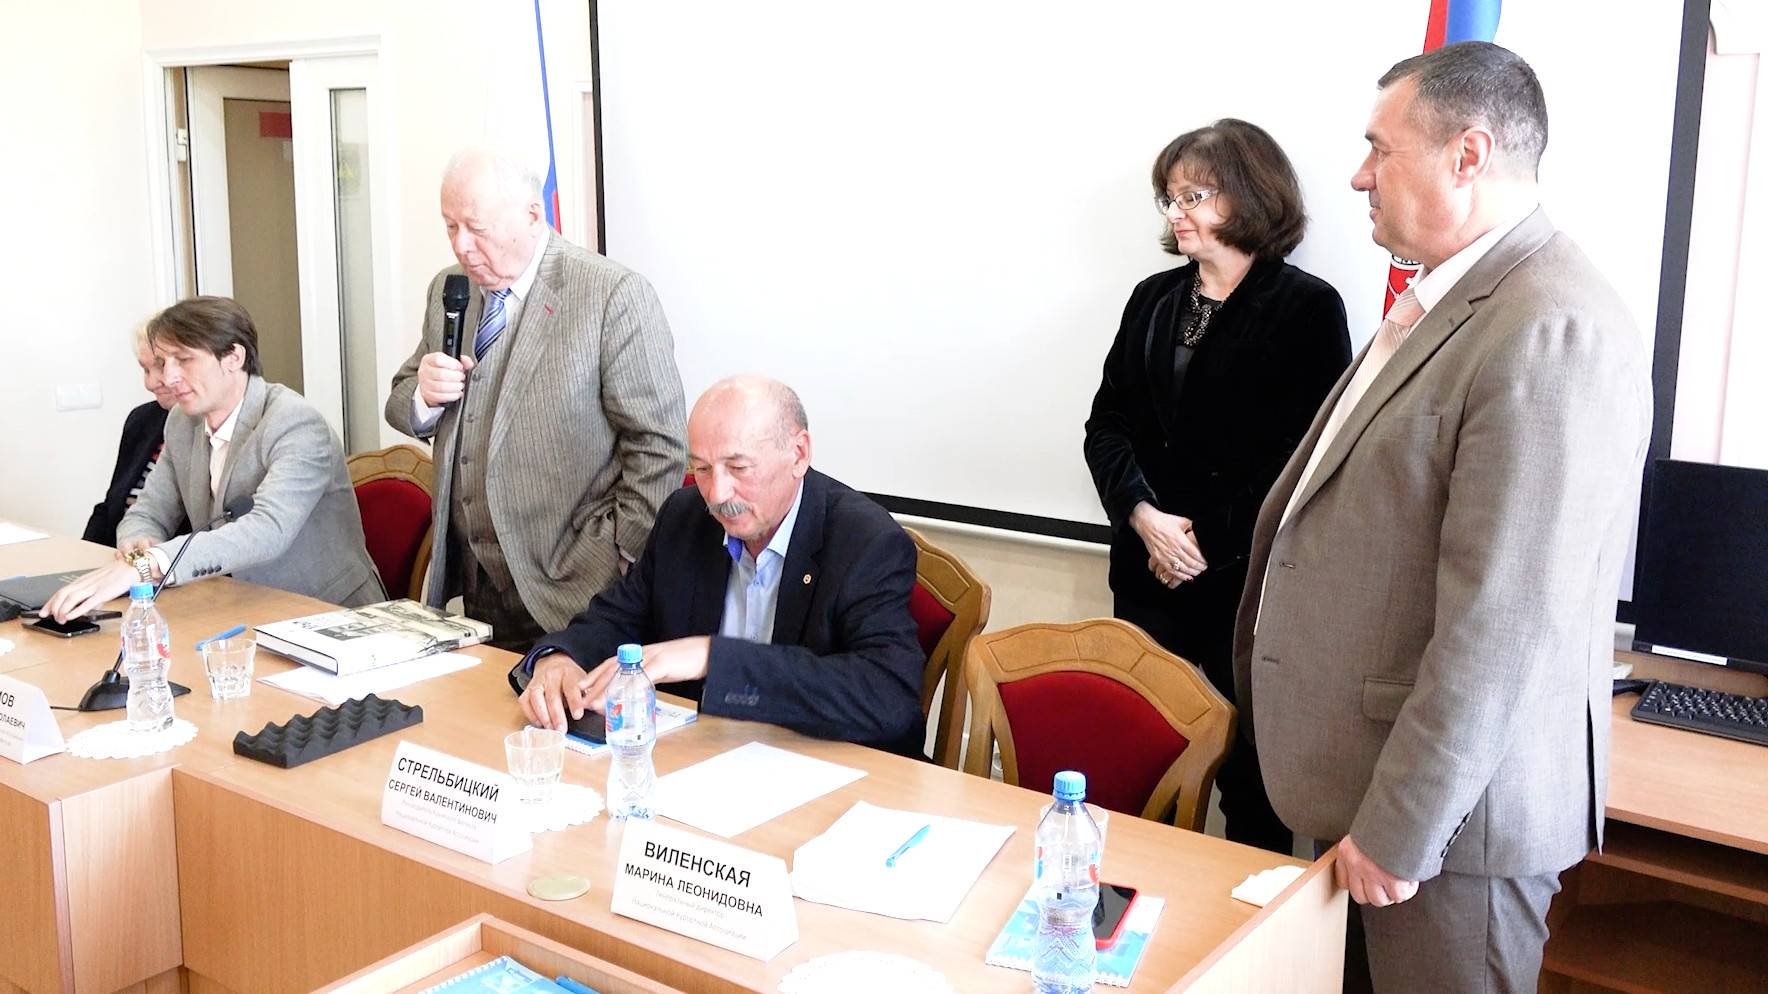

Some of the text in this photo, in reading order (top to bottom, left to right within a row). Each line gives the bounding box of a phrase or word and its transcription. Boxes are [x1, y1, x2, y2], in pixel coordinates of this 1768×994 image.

[0, 690, 15, 707] ОВ
[388, 779, 422, 799] СЕРГЕЙ
[423, 790, 498, 824] ВАЛЕНТИНОВИЧ
[398, 757, 500, 802] СТРЕЛЬБИЦКИЙ
[644, 841, 751, 887] ВИЛЕНСКАЯ
[624, 863, 674, 888] МАРИНА
[677, 879, 763, 917] ЛЕОНИДОВНА
